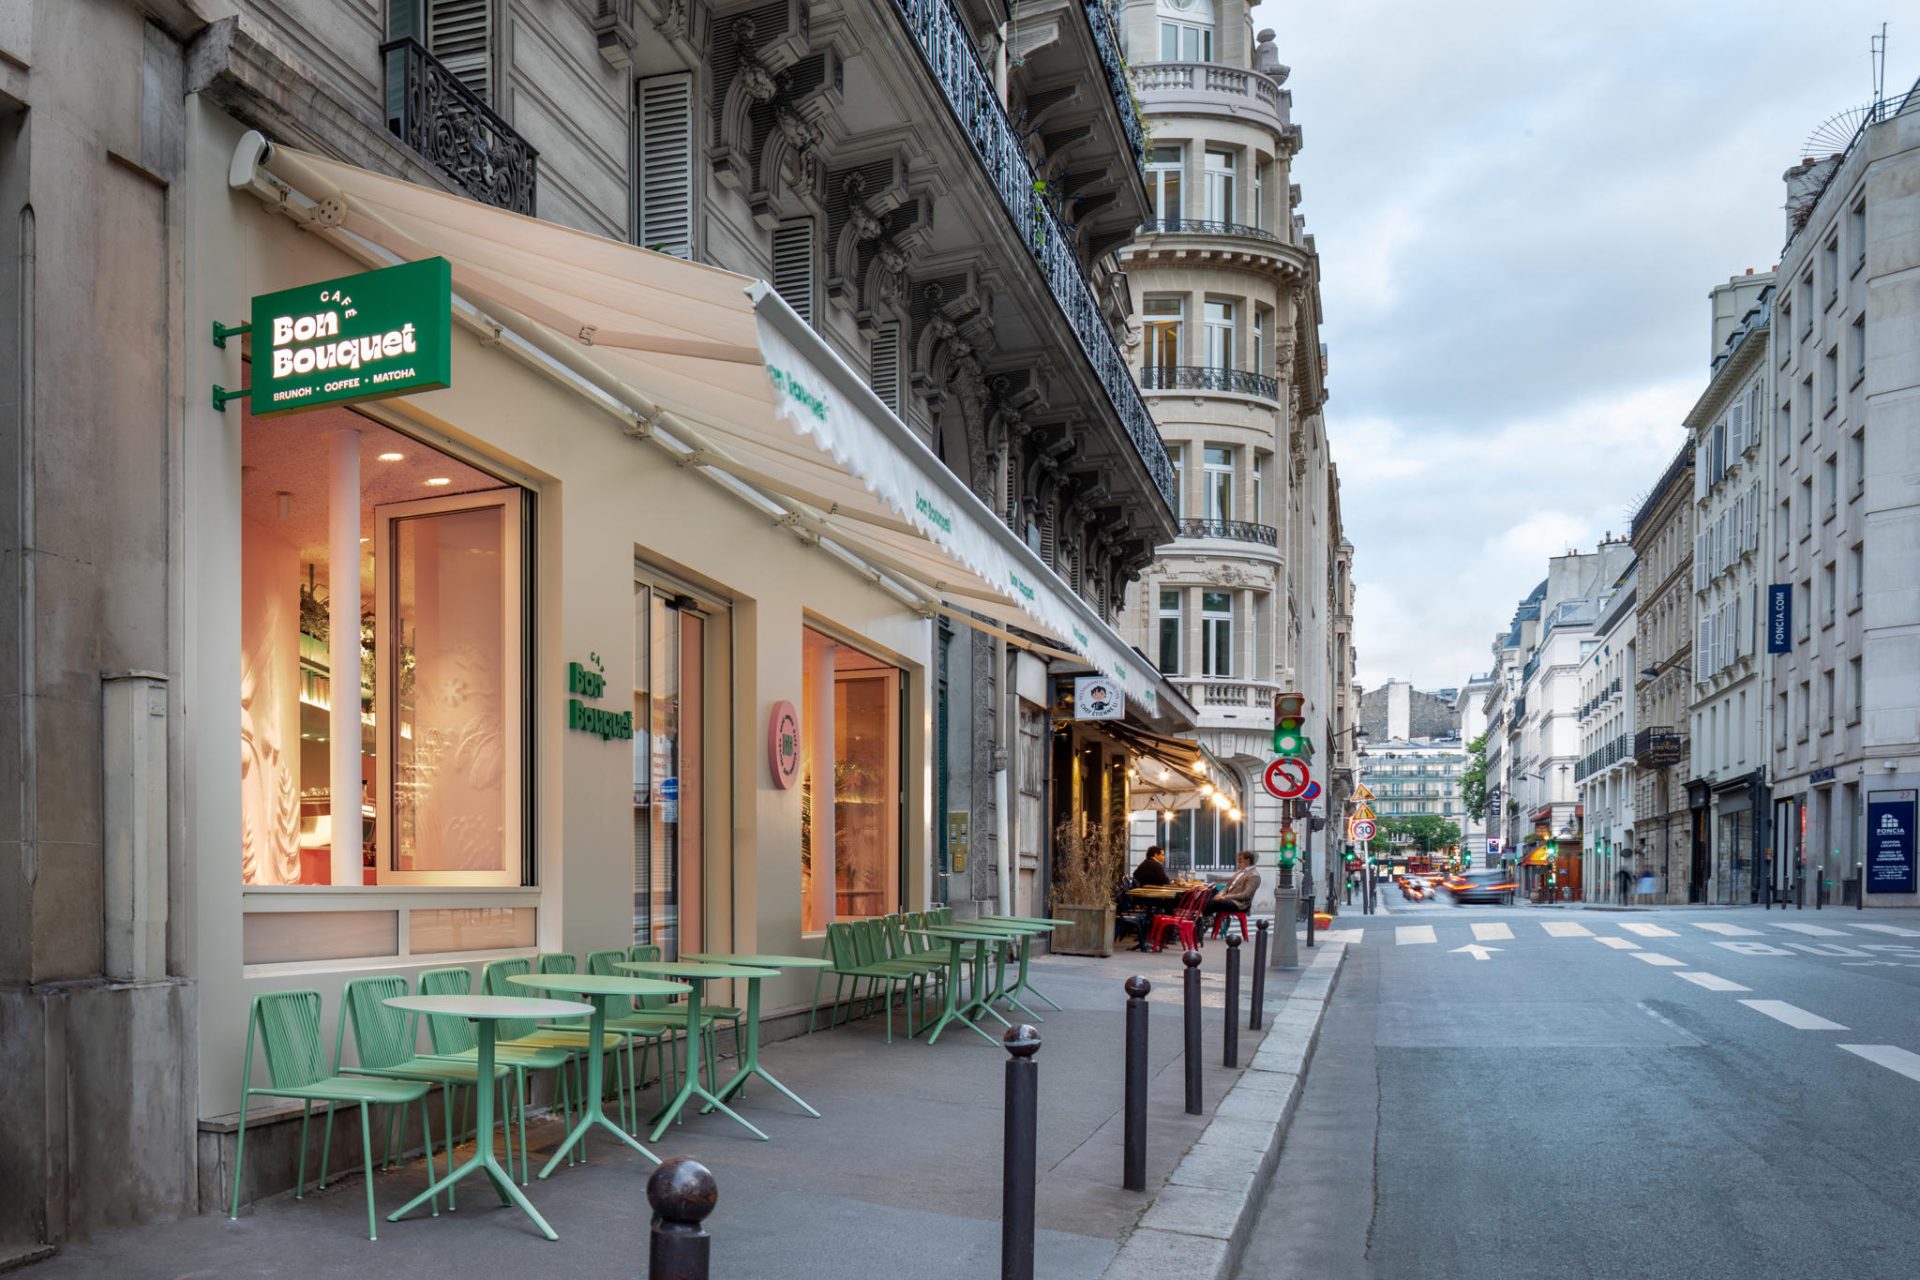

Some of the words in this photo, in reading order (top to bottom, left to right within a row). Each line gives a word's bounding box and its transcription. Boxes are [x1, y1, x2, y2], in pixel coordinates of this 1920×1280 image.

[272, 310, 338, 347] Bon
[272, 322, 417, 379] Bouquet
[273, 386, 312, 402] BRUNCH
[324, 377, 360, 393] COFFEE
[373, 368, 416, 384] MATCHA
[1775, 592, 1784, 645] FONCIA.COM
[569, 662, 604, 698] Bon
[569, 699, 634, 741] Bouquet
[1358, 825, 1372, 835] 30
